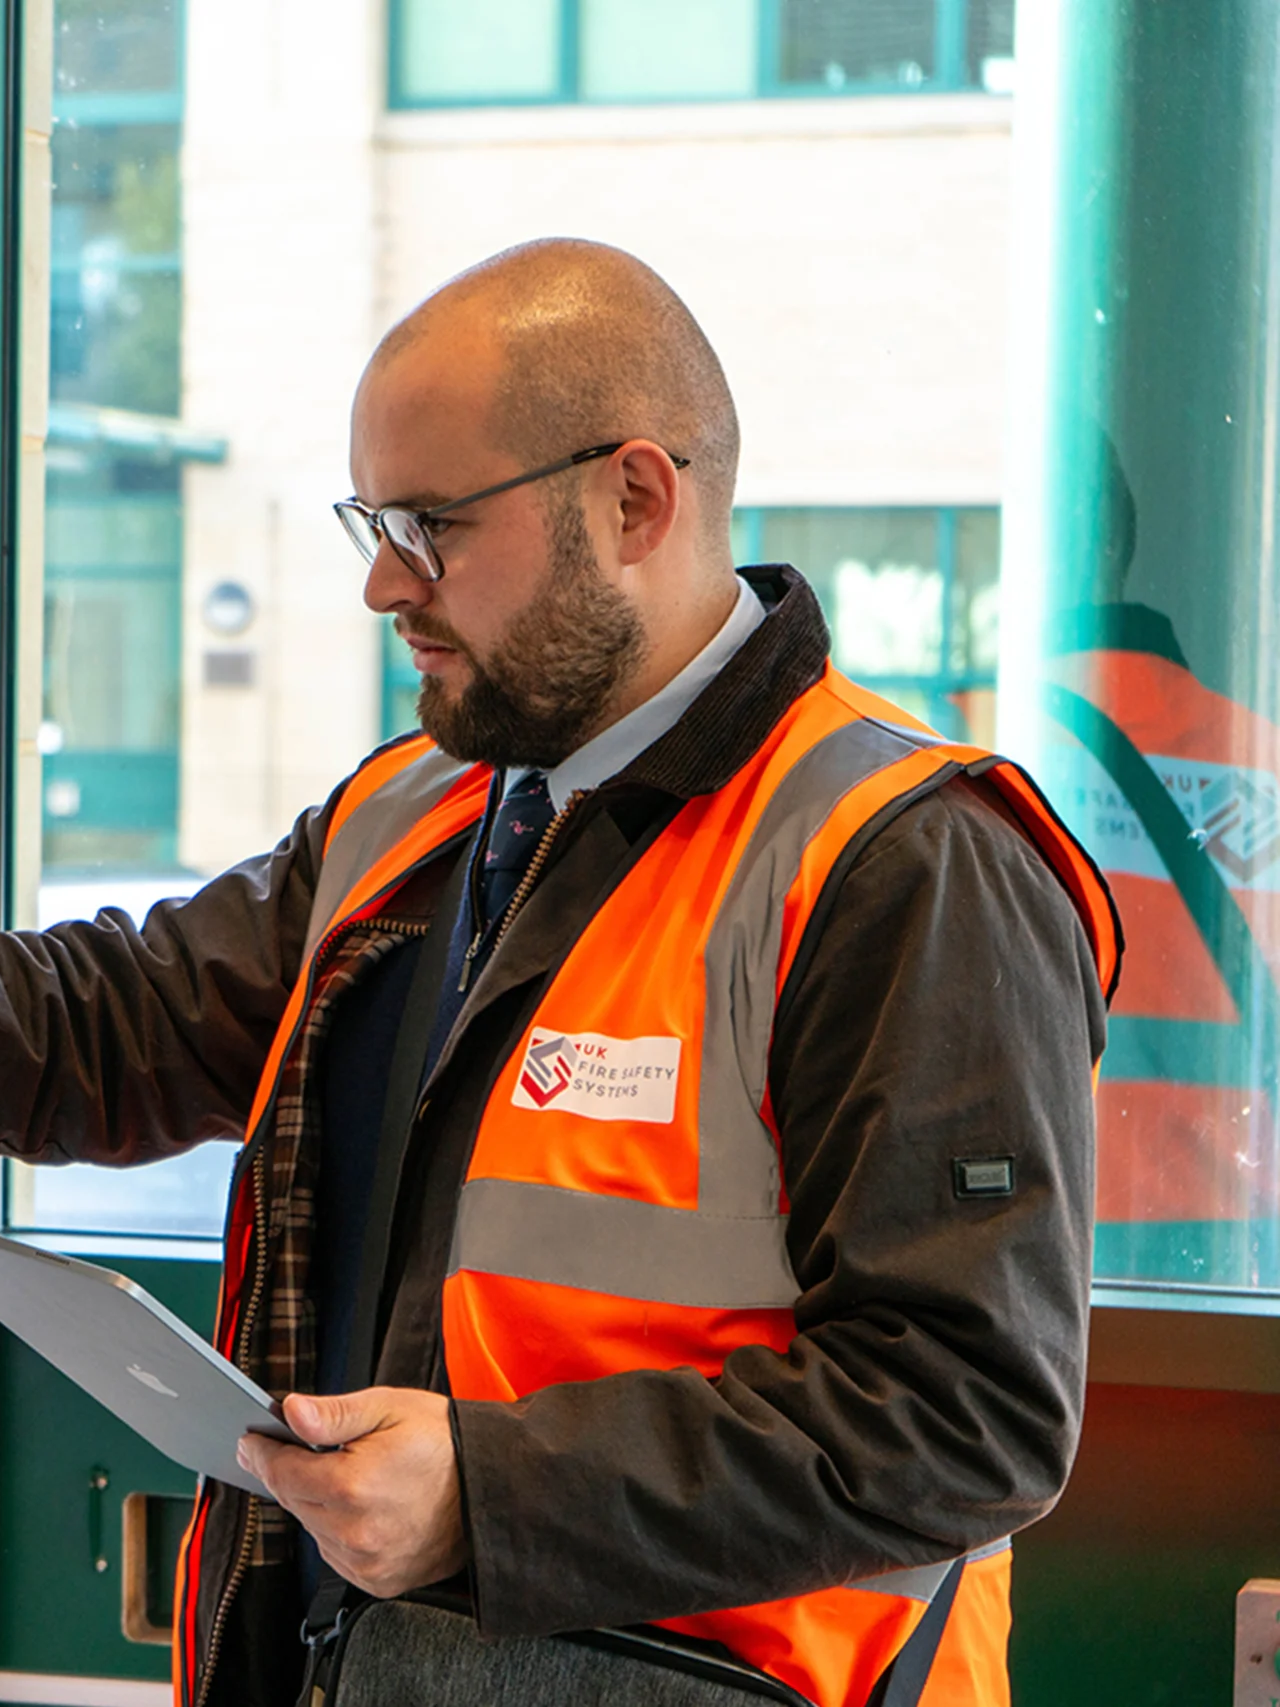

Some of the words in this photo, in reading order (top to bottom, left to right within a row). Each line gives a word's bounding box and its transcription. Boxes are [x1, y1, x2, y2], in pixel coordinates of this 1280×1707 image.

[583, 1043, 608, 1059] UK
[578, 1060, 618, 1080] FIRE
[622, 1066, 676, 1081] SAFETY
[573, 1079, 638, 1098] SYSTEMS
